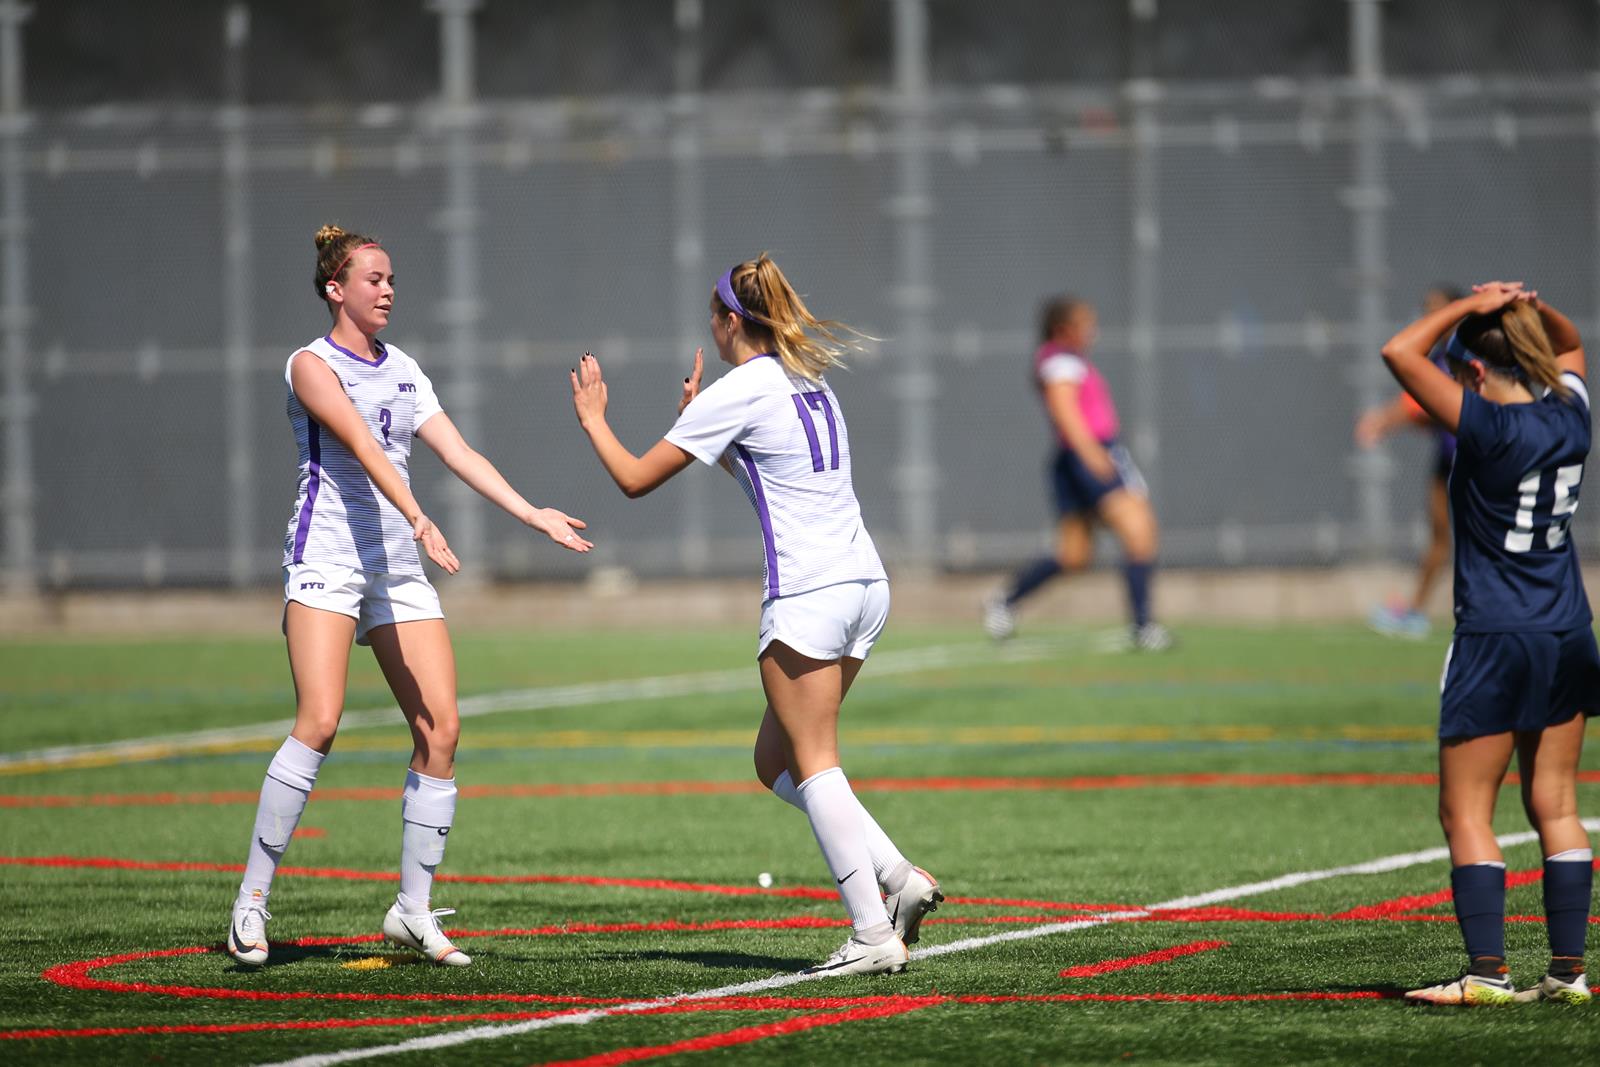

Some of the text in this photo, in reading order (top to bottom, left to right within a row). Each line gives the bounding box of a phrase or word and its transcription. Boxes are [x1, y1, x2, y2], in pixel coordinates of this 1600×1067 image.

[791, 390, 839, 473] 17
[1504, 463, 1583, 553] 15
[300, 581, 325, 591] NYU
